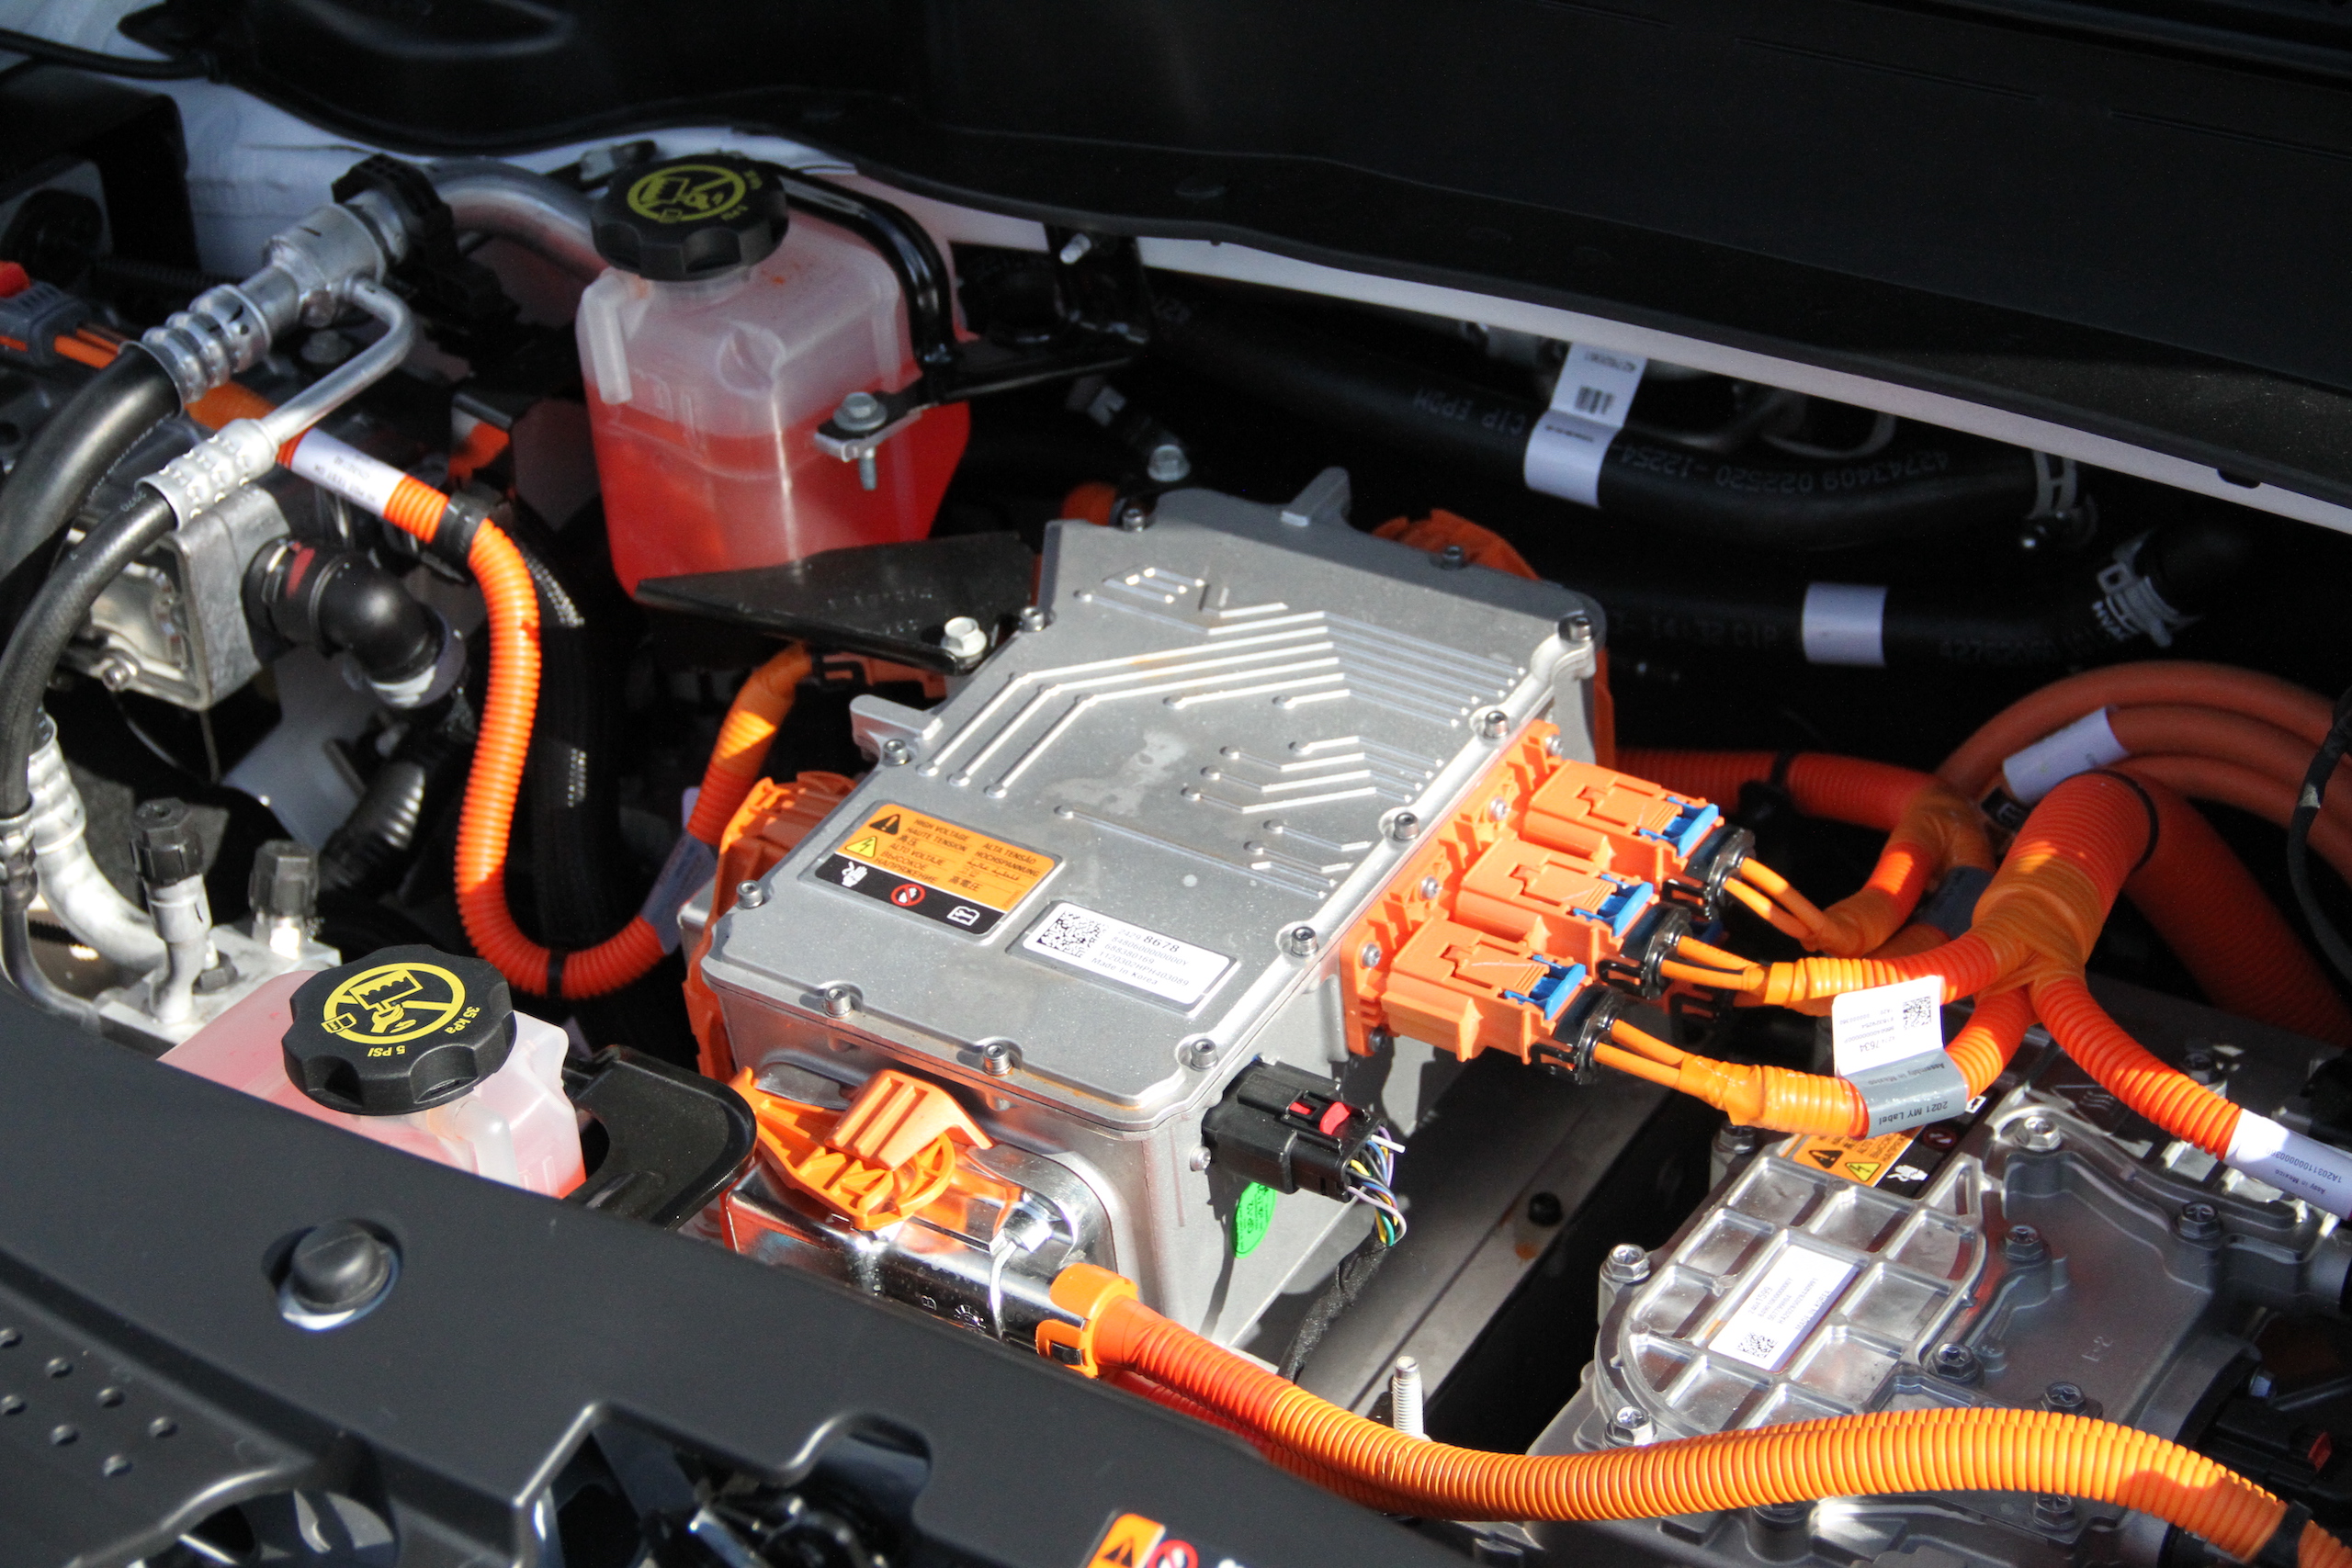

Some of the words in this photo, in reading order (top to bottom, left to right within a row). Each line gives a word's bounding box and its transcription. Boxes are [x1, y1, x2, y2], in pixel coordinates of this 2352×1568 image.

[911, 818, 935, 829] HIGH
[932, 826, 971, 841] VOLTAGE
[903, 827, 933, 839] HAUTE
[934, 838, 969, 852] TENSION
[879, 851, 929, 871] ВЫСОКОЕ
[888, 842, 910, 853] ALTO
[909, 850, 946, 865] VOLTAJE
[981, 842, 1004, 852] ALTA
[1001, 849, 1038, 864] TENSÃO
[872, 857, 939, 884] НАПРЯЖЕНИЕ
[971, 851, 1042, 876] HOCHSPANNUNG
[1141, 934, 1182, 953] 8678
[1091, 957, 1117, 970] Made
[1130, 971, 1159, 985] Korea
[463, 1006, 480, 1018] 35
[445, 1018, 471, 1034] kPa
[368, 1048, 392, 1056] PSI
[396, 1045, 406, 1055] 5
[1860, 1039, 1879, 1053] 7634
[1908, 1063, 1944, 1076] Assembly
[1907, 1108, 1922, 1117] MY
[1926, 1100, 1948, 1112] 2021
[1879, 1111, 1903, 1124] Label
[2274, 1168, 2299, 1184] Mexico
[2309, 1181, 2324, 1195] Assy
[1794, 1314, 1812, 1330] MADE
